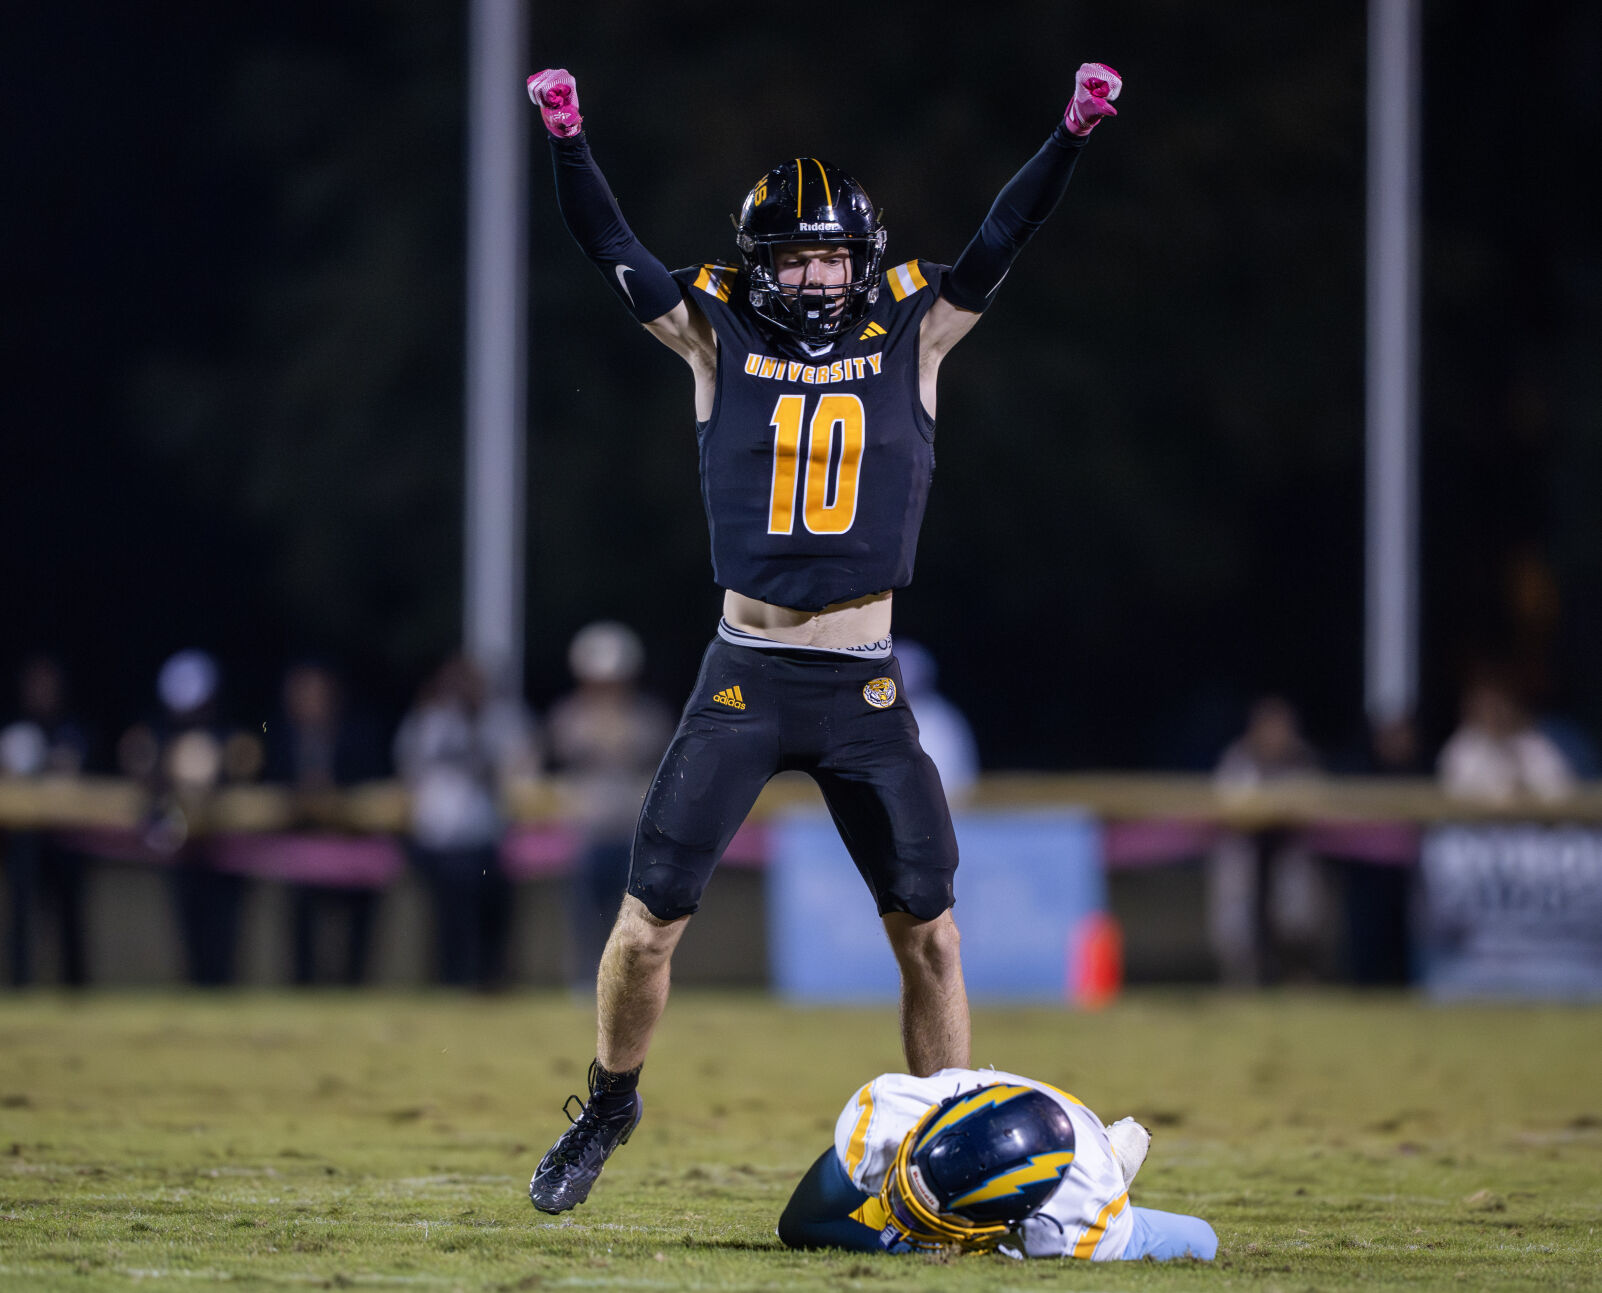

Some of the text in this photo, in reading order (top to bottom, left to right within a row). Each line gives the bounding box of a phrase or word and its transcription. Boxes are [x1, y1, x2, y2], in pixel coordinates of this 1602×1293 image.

[744, 352, 882, 384] UNIVERSITY
[767, 393, 865, 535] 10
[713, 694, 746, 710] adidas
